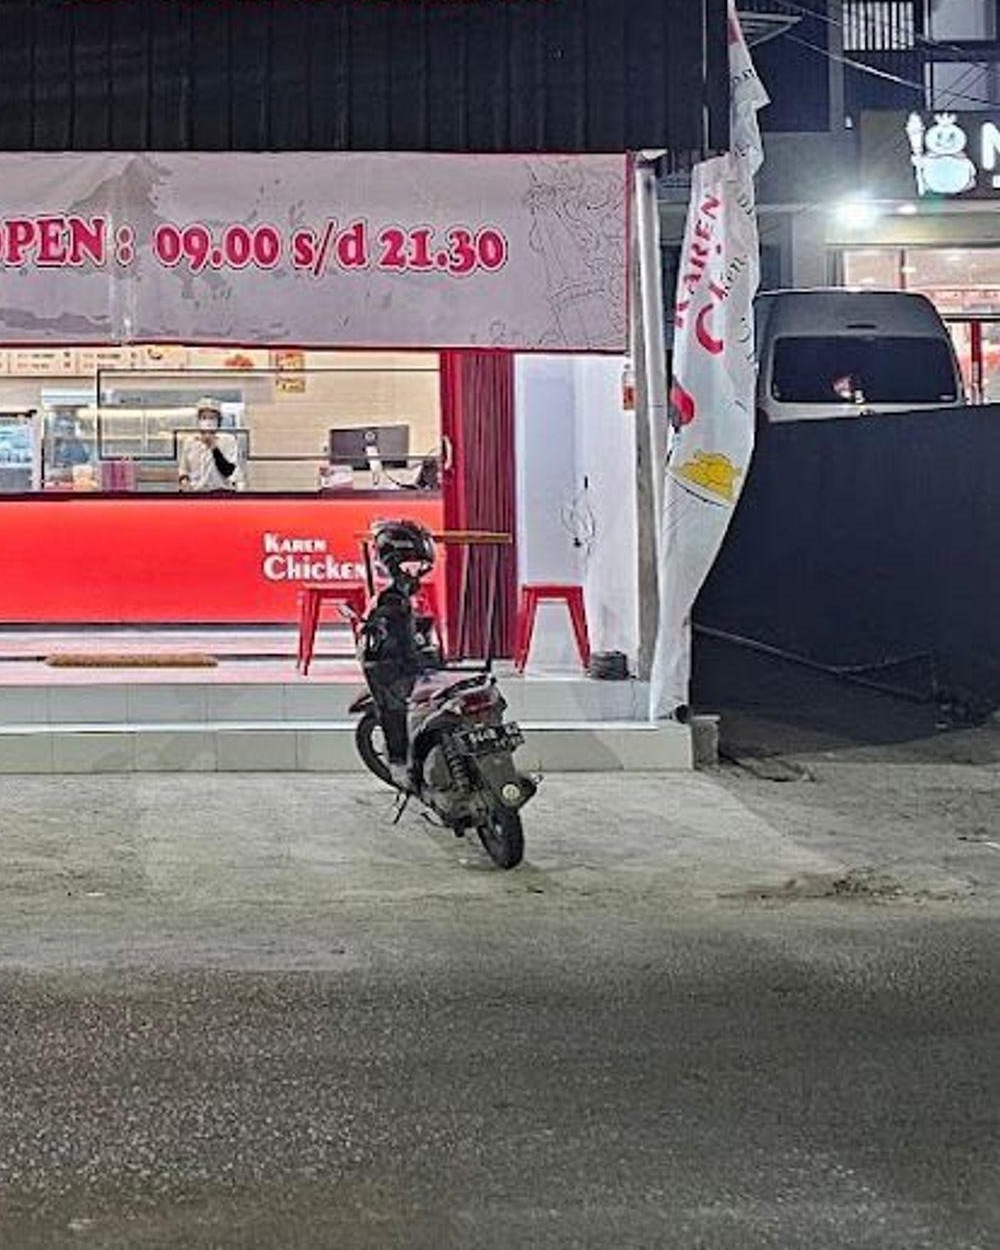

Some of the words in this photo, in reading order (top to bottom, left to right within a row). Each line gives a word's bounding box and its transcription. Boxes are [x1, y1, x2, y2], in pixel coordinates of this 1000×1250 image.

[153, 224, 281, 272] 09.00
[292, 219, 368, 278] s/d
[377, 226, 508, 275] 21.30
[263, 532, 328, 553] KAREN
